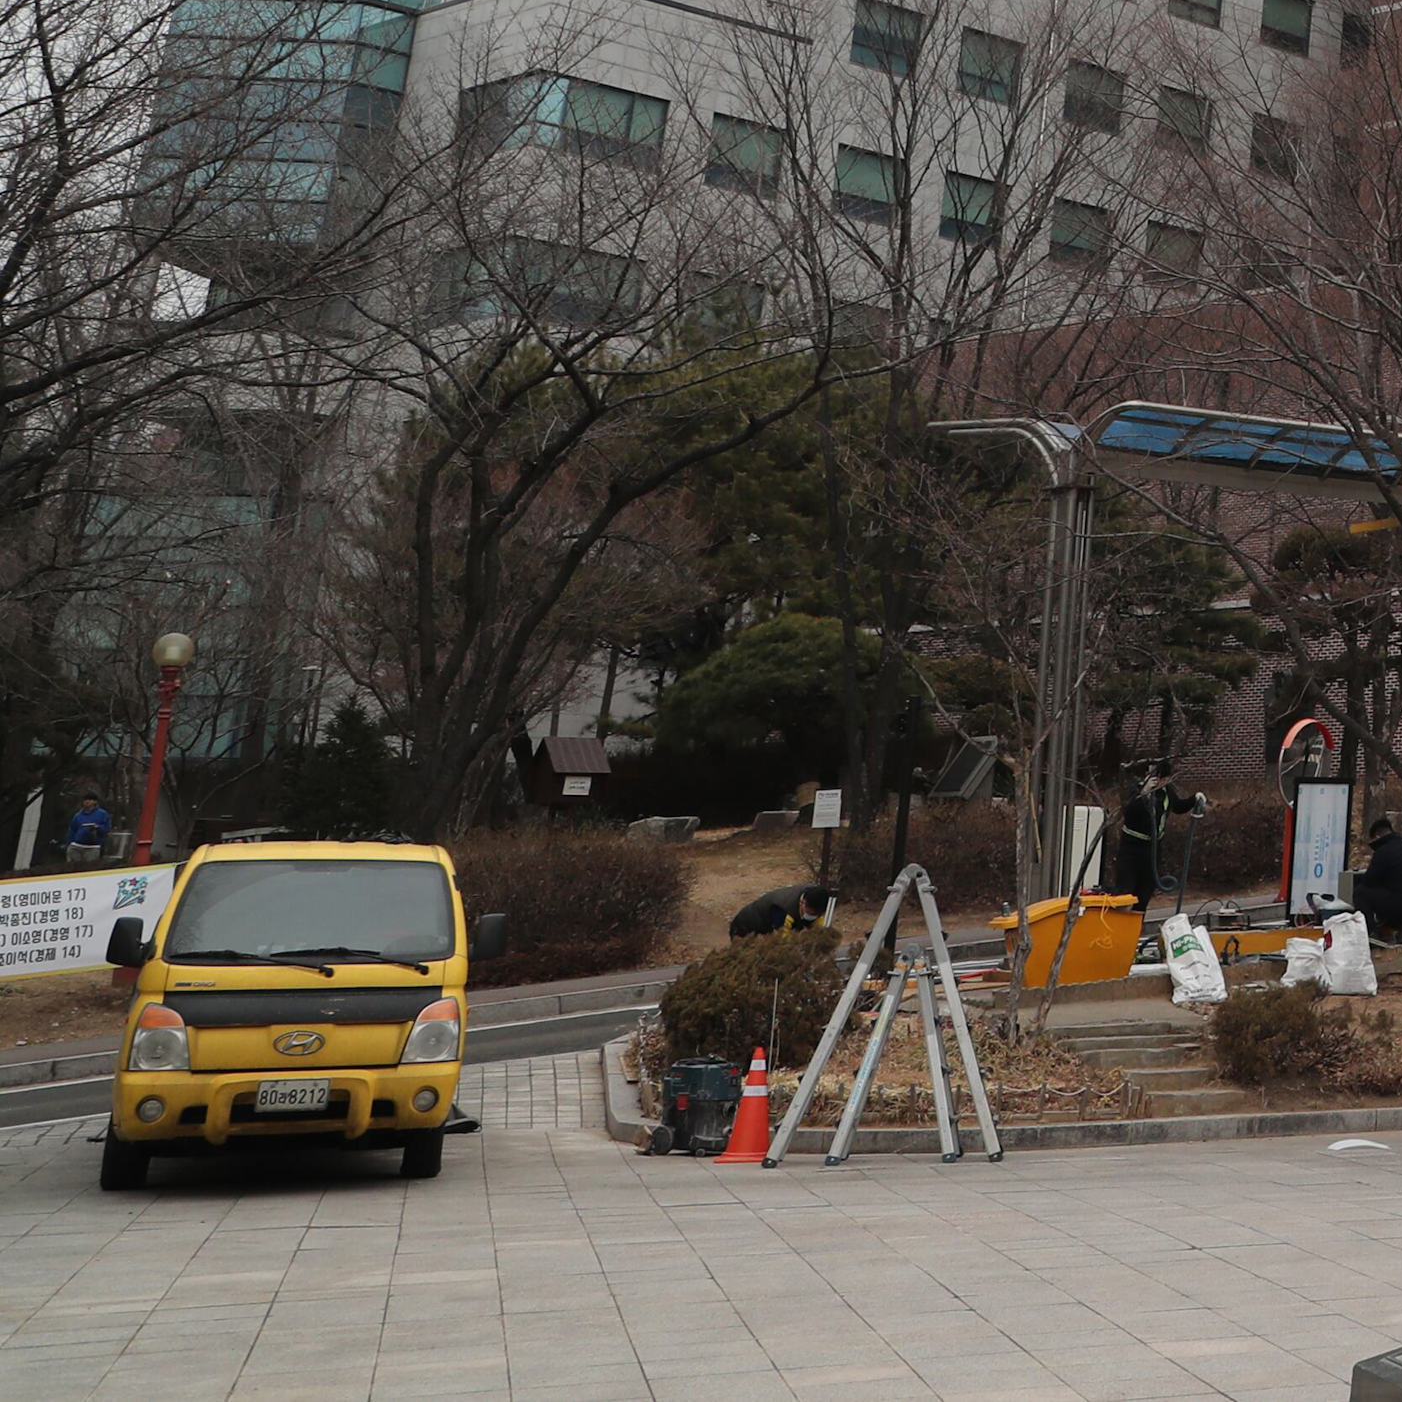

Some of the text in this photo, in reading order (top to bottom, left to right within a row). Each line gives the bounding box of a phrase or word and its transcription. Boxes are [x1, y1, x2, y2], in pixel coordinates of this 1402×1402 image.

[67, 888, 87, 901] 17)
[65, 907, 84, 920] 18)
[11, 927, 70, 946] 이소영(경영
[75, 924, 94, 938] 17)
[62, 945, 81, 958] 14)
